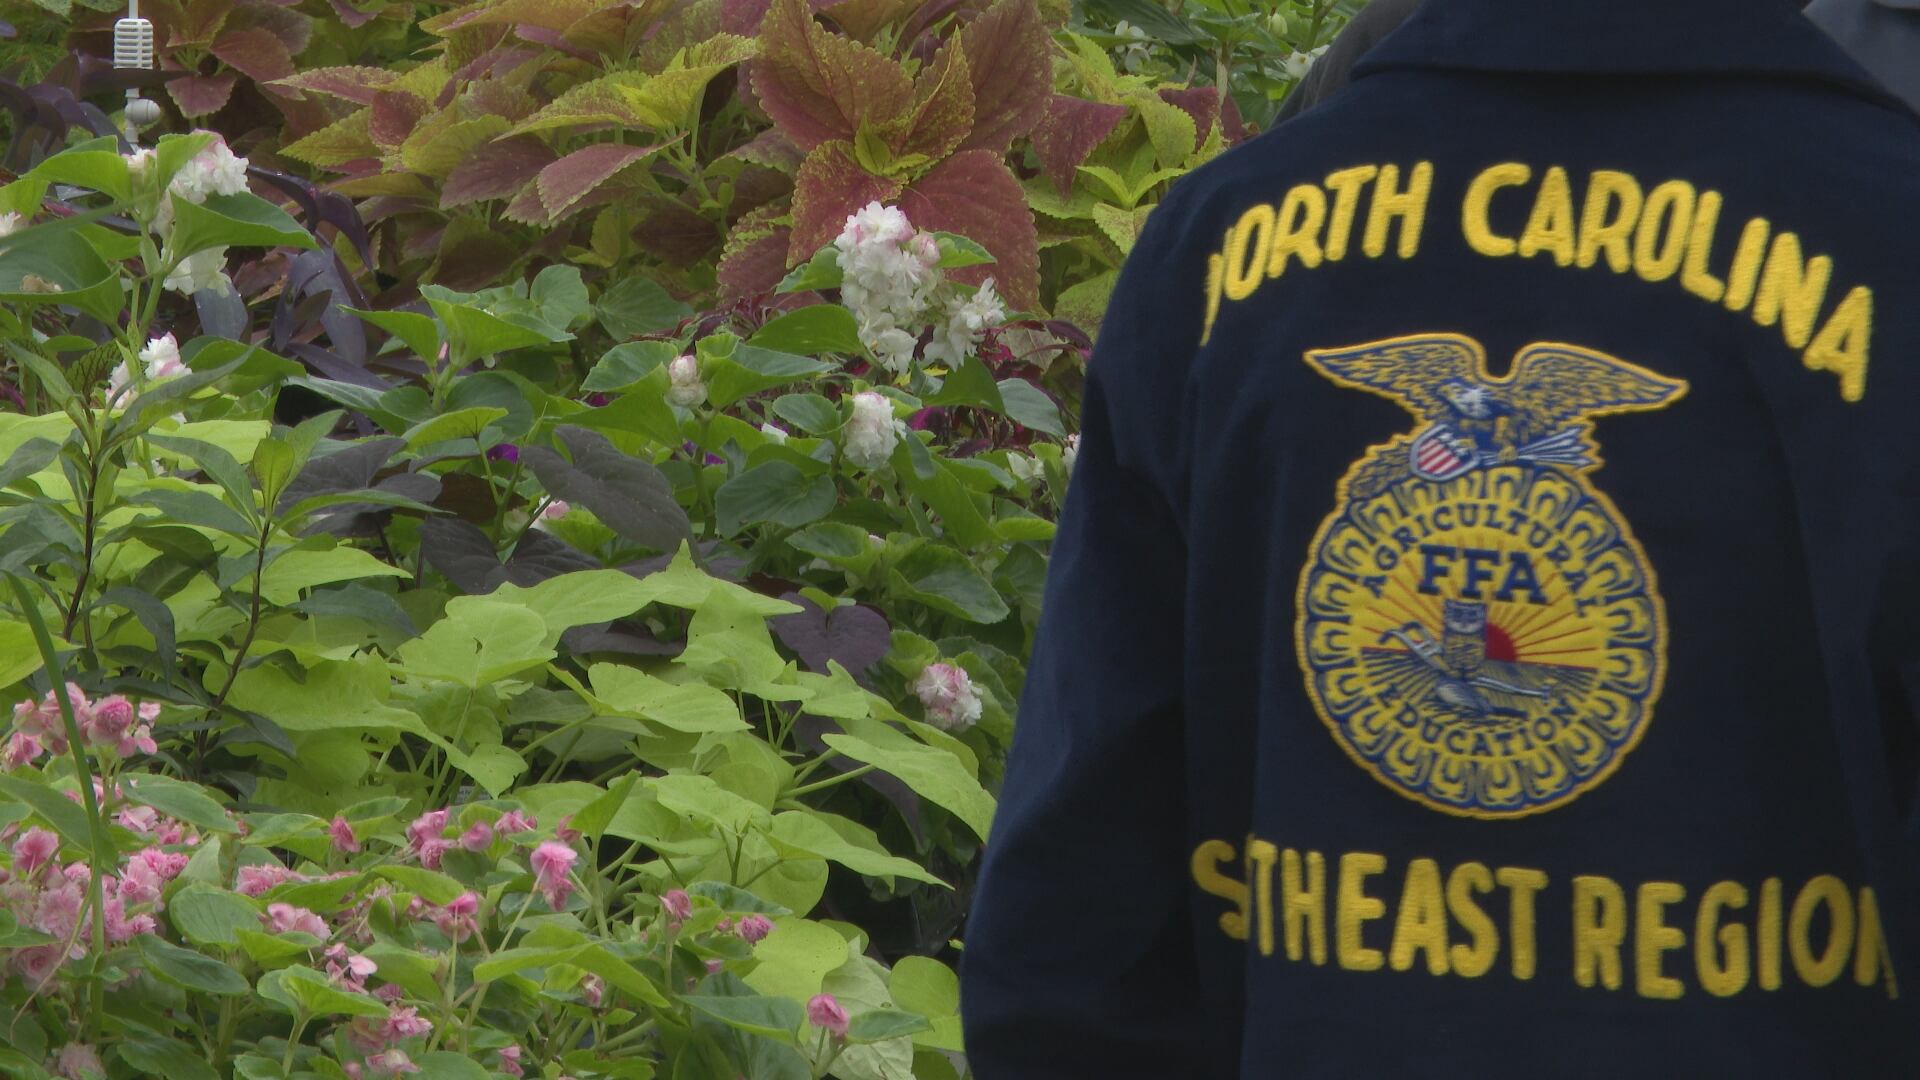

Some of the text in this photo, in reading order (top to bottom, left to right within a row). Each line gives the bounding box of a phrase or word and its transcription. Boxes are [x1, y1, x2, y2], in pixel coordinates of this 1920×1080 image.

[1461, 162, 1873, 402] CAROLINA
[1361, 503, 1598, 618] AGRICULTURAL
[1418, 543, 1548, 604] FFA
[1377, 682, 1577, 756] EDUCATION
